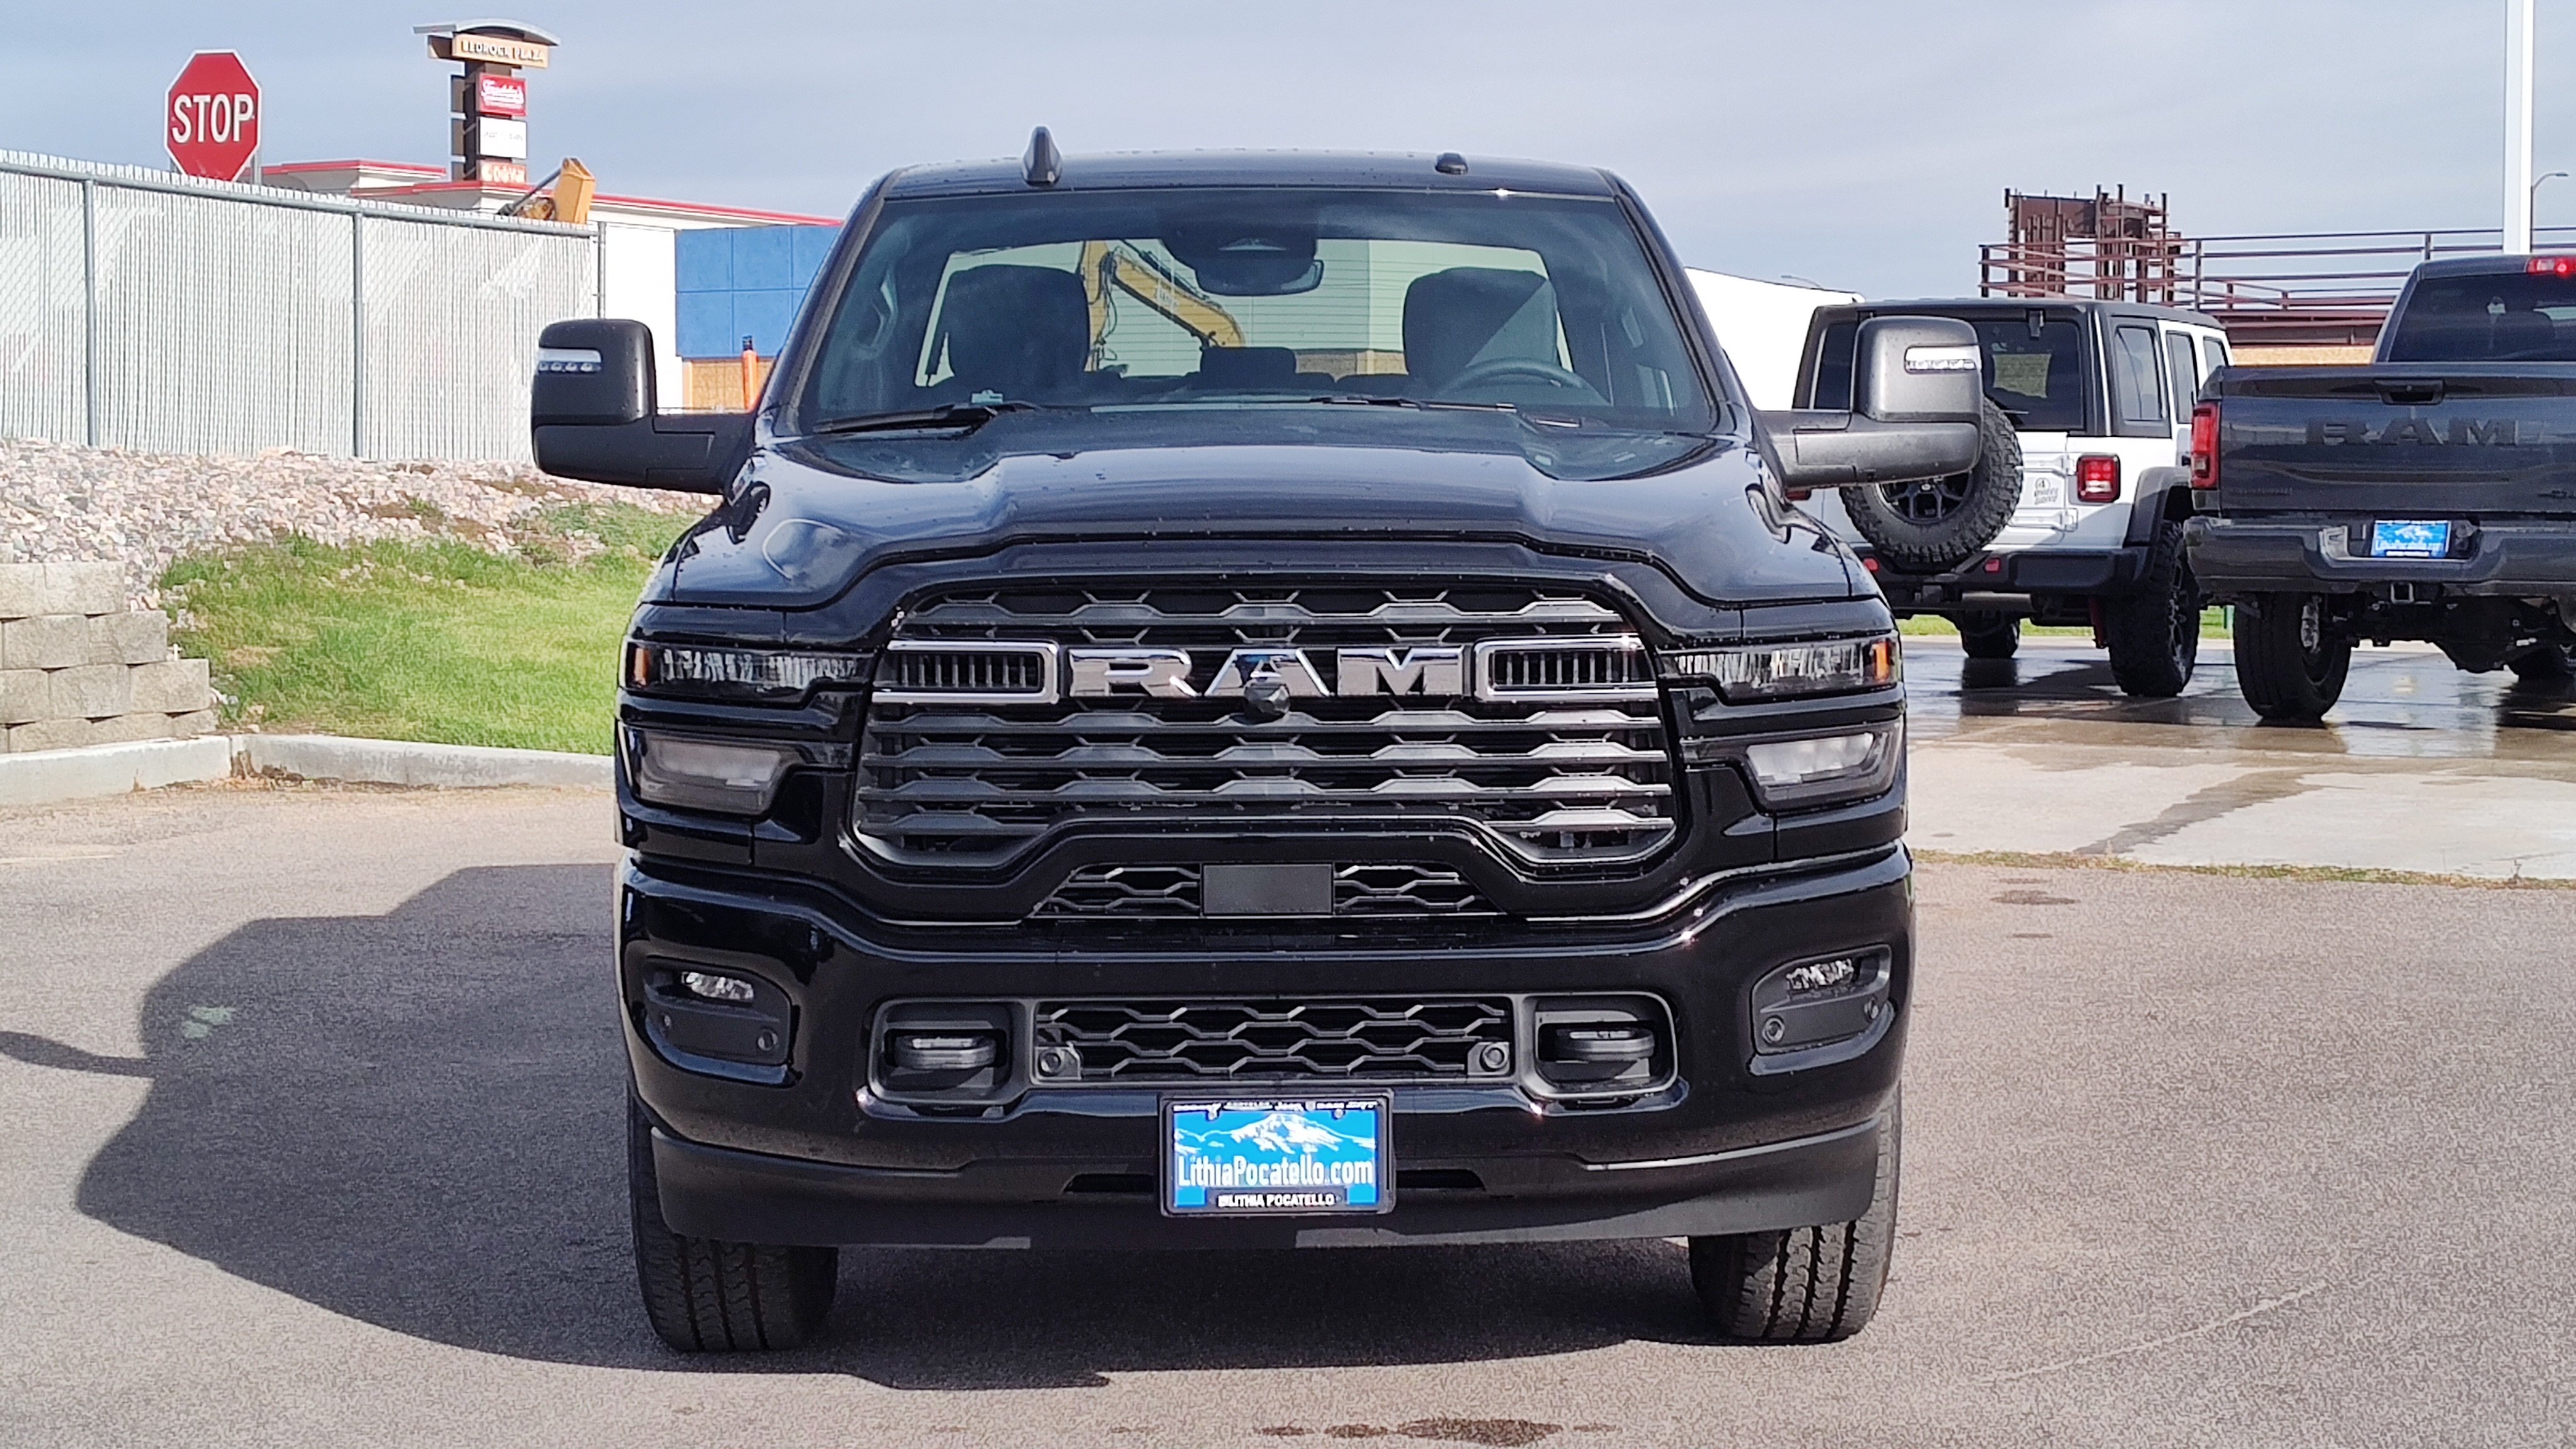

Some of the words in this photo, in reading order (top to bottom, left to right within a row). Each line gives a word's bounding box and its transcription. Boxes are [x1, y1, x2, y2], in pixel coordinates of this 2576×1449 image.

[171, 93, 255, 143] STOP
[2307, 417, 2518, 445] RAM
[1069, 647, 1465, 697] RAM
[1177, 1154, 1374, 1187] LithiaPocatello.com
[1266, 1193, 1335, 1207] POCATELLO
